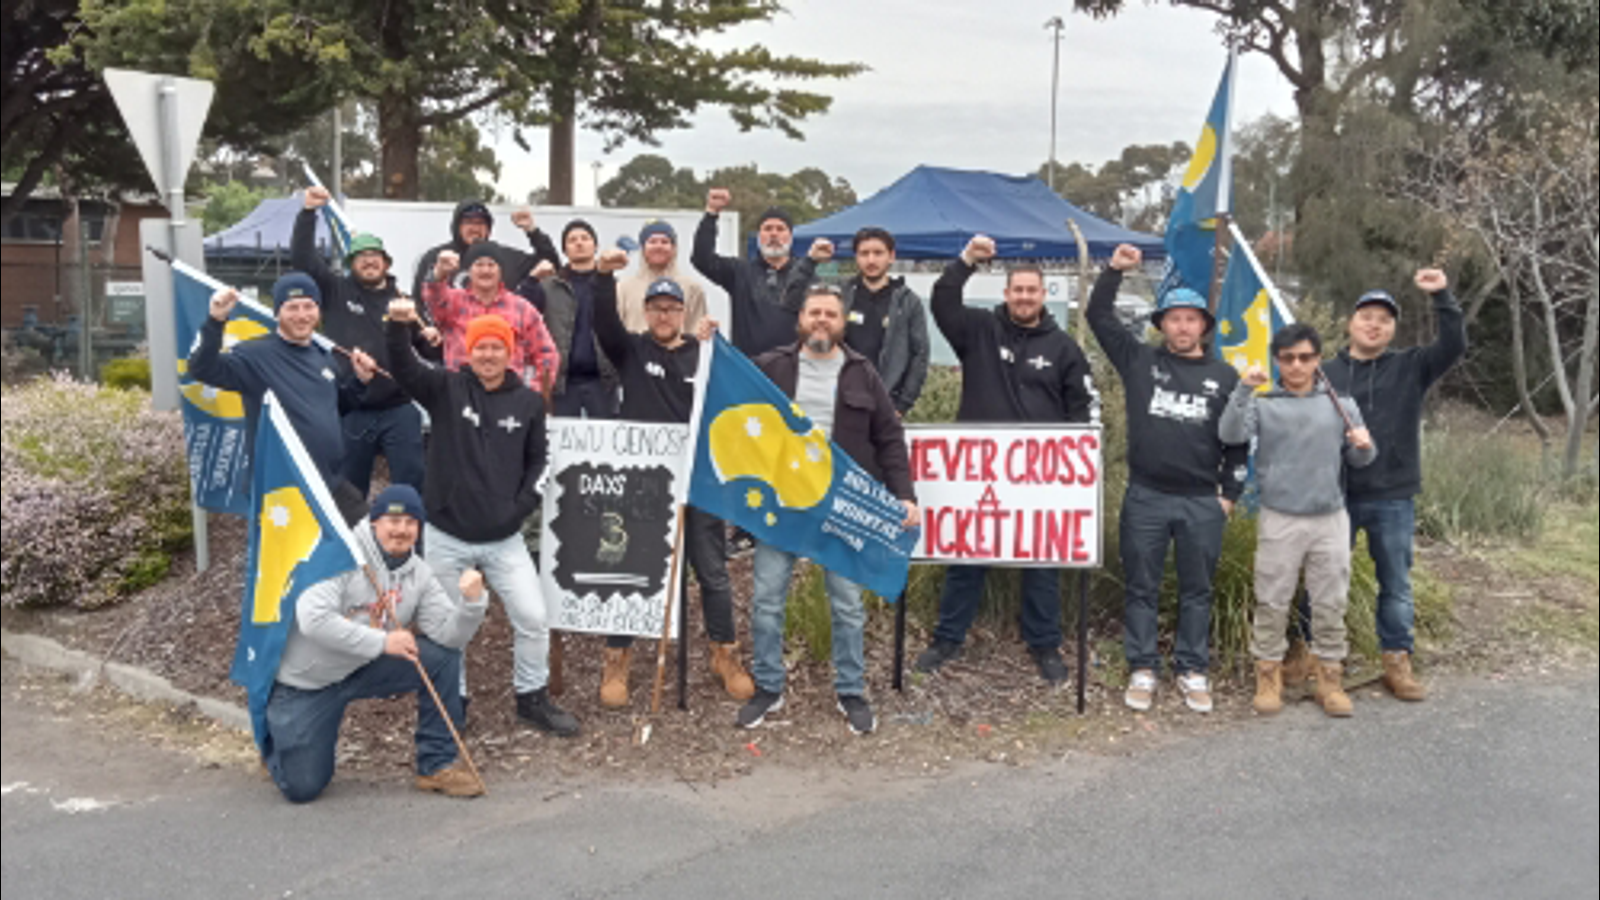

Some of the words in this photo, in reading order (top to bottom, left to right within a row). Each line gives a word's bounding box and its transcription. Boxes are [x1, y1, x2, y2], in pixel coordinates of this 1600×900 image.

[1004, 436, 1098, 487] CROSS
[976, 484, 1000, 511] A
[924, 507, 1010, 558] ICKET
[1013, 509, 1092, 563] LINE
